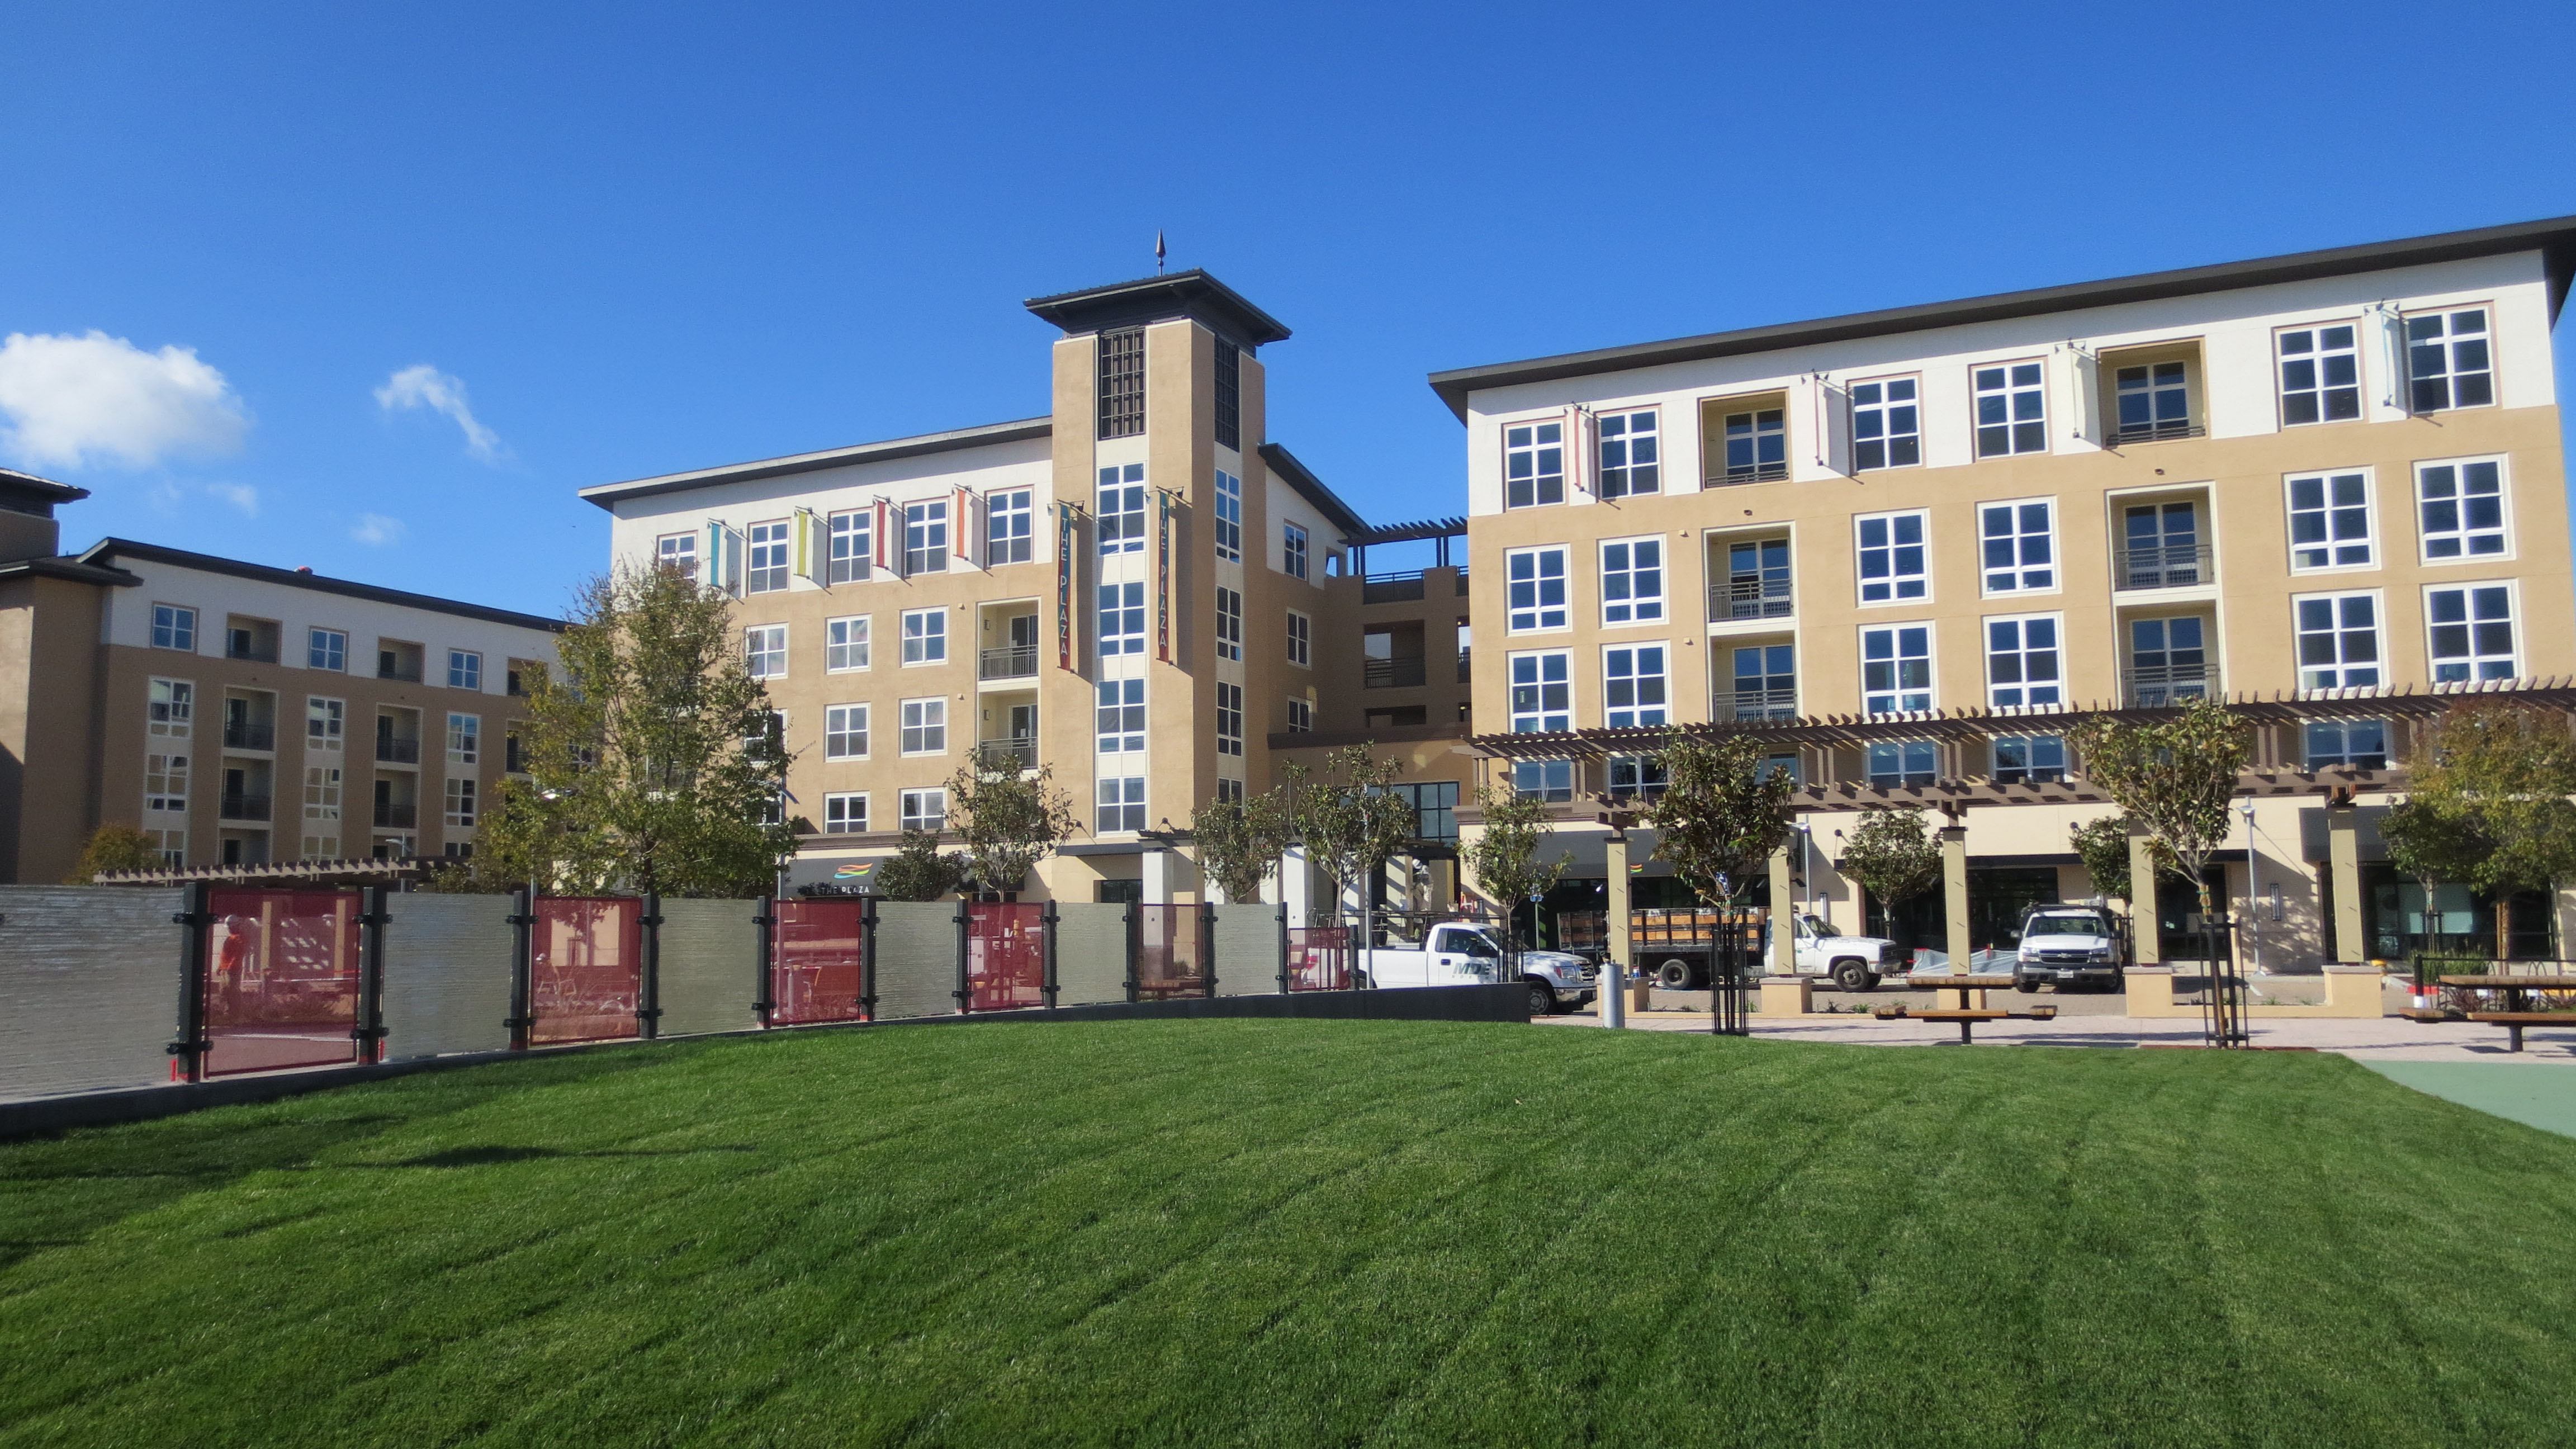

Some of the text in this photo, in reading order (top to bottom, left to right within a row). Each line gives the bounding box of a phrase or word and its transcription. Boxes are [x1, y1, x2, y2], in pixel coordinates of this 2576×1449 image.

[1059, 517, 1069, 656] THE PLAZA
[1159, 564, 1167, 647] PLAZA
[821, 886, 870, 894] THE PLAZA
[1453, 962, 1493, 975] MDE
